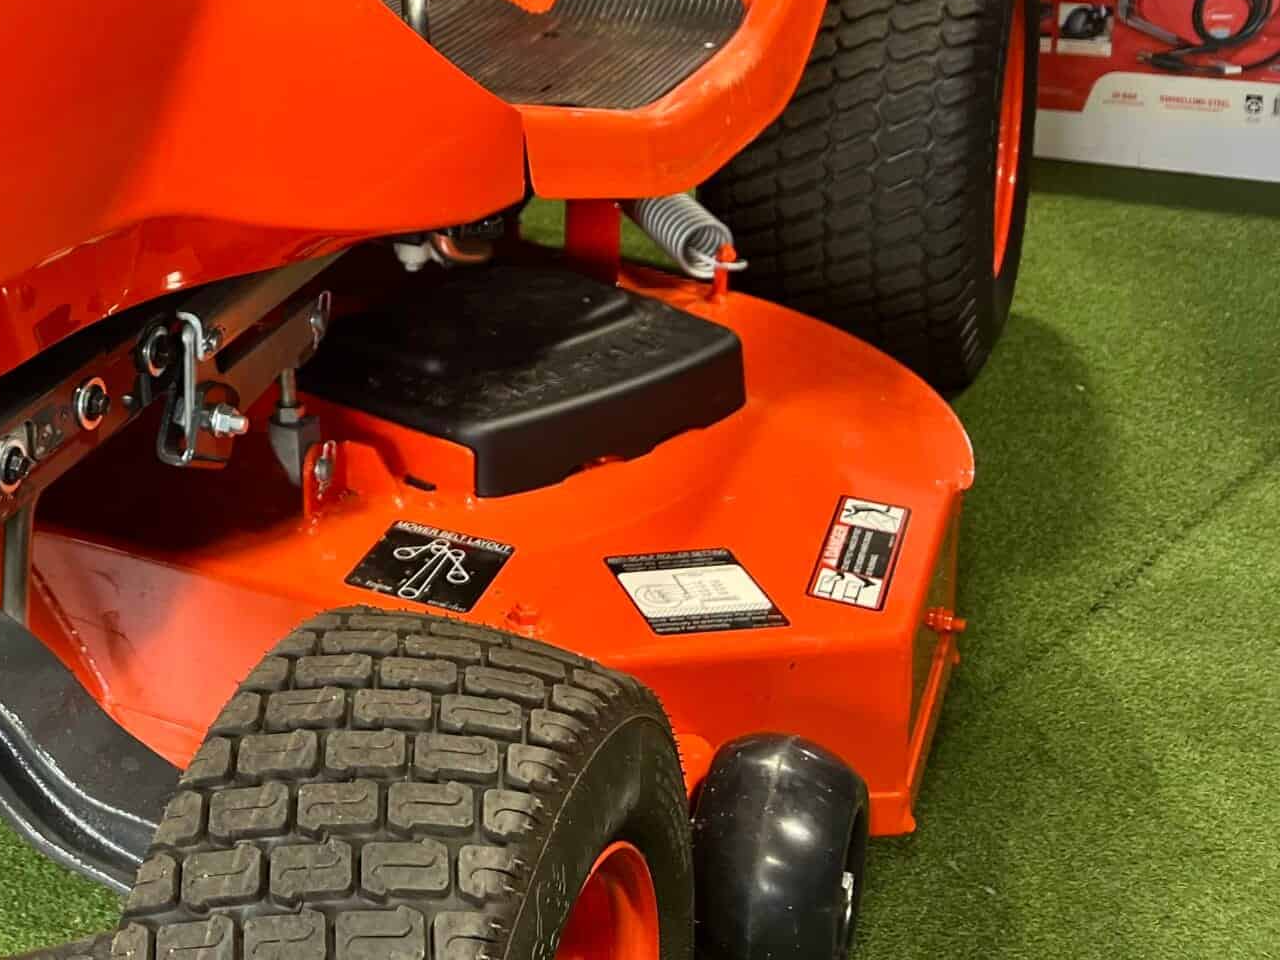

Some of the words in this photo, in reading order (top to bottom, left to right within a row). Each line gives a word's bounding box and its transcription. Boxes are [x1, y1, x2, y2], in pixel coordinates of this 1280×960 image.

[396, 520, 438, 537] MOWER
[440, 529, 467, 544] BELT
[467, 535, 512, 554] LAYOUT
